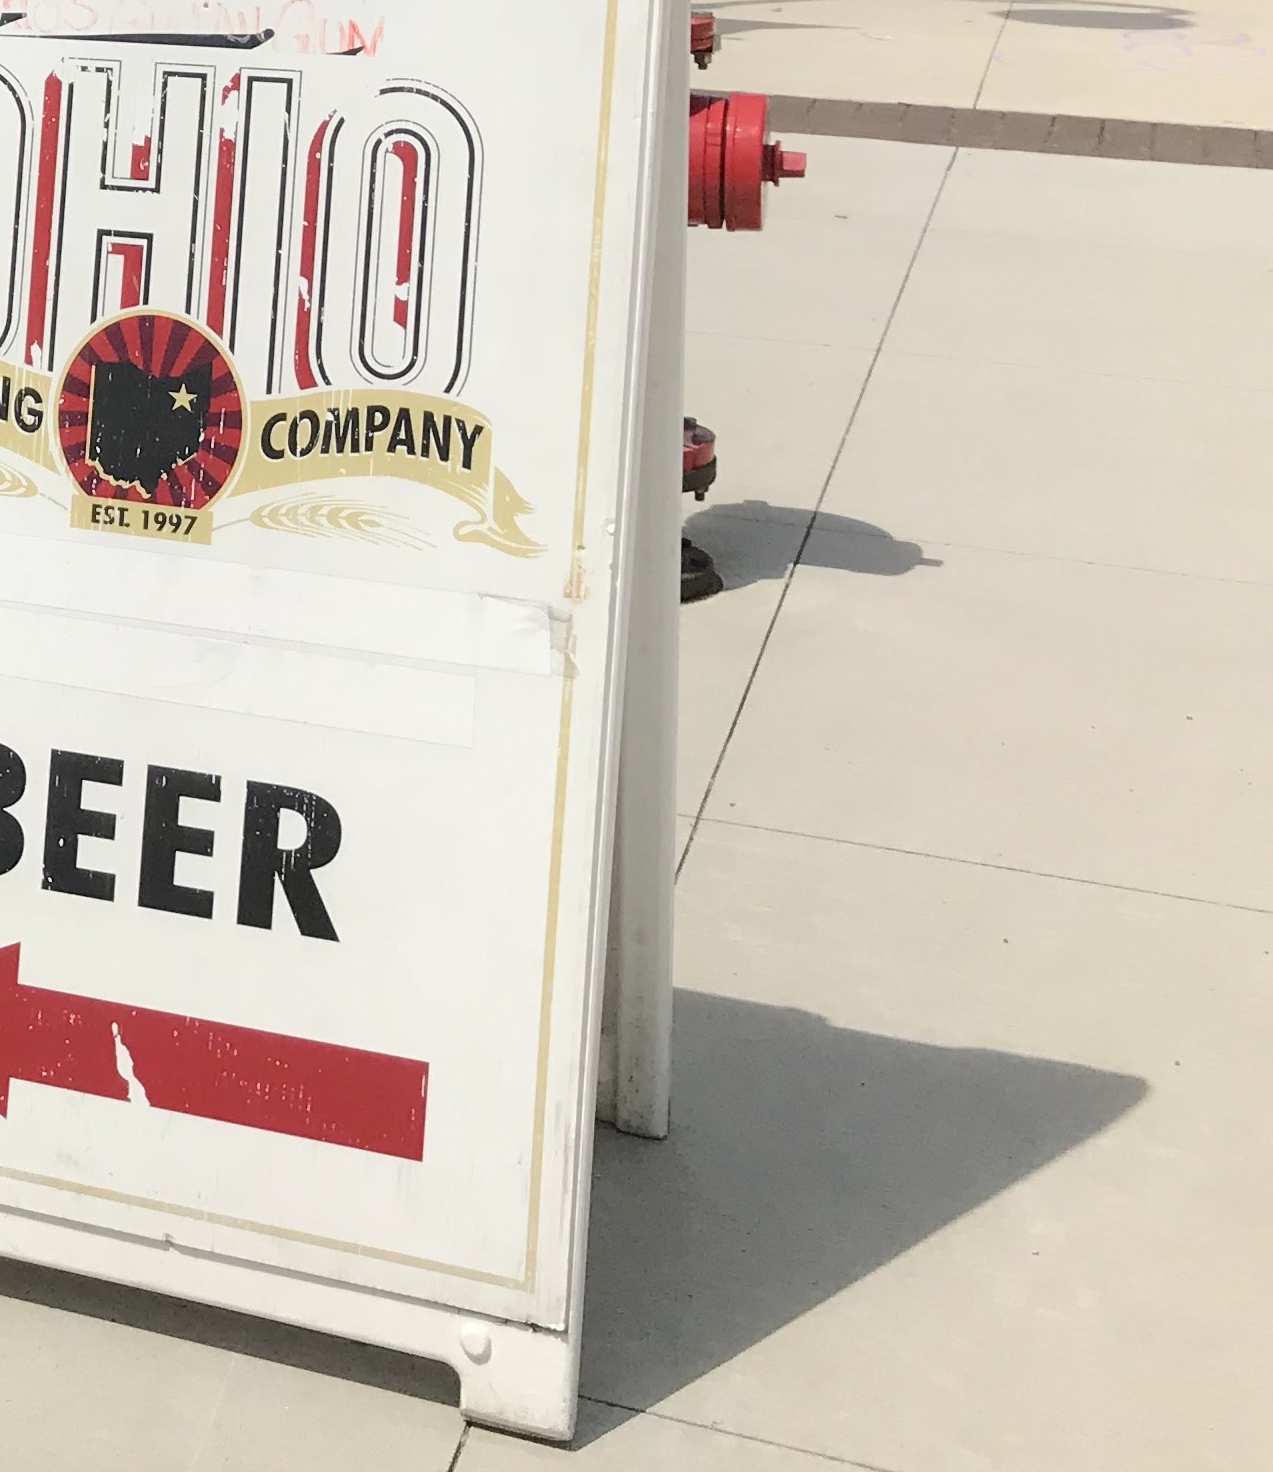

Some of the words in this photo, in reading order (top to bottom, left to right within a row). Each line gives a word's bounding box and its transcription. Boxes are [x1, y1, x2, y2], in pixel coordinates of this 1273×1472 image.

[260, 404, 485, 471] COMPANY
[91, 503, 131, 528] EST.
[142, 509, 199, 536] 1997
